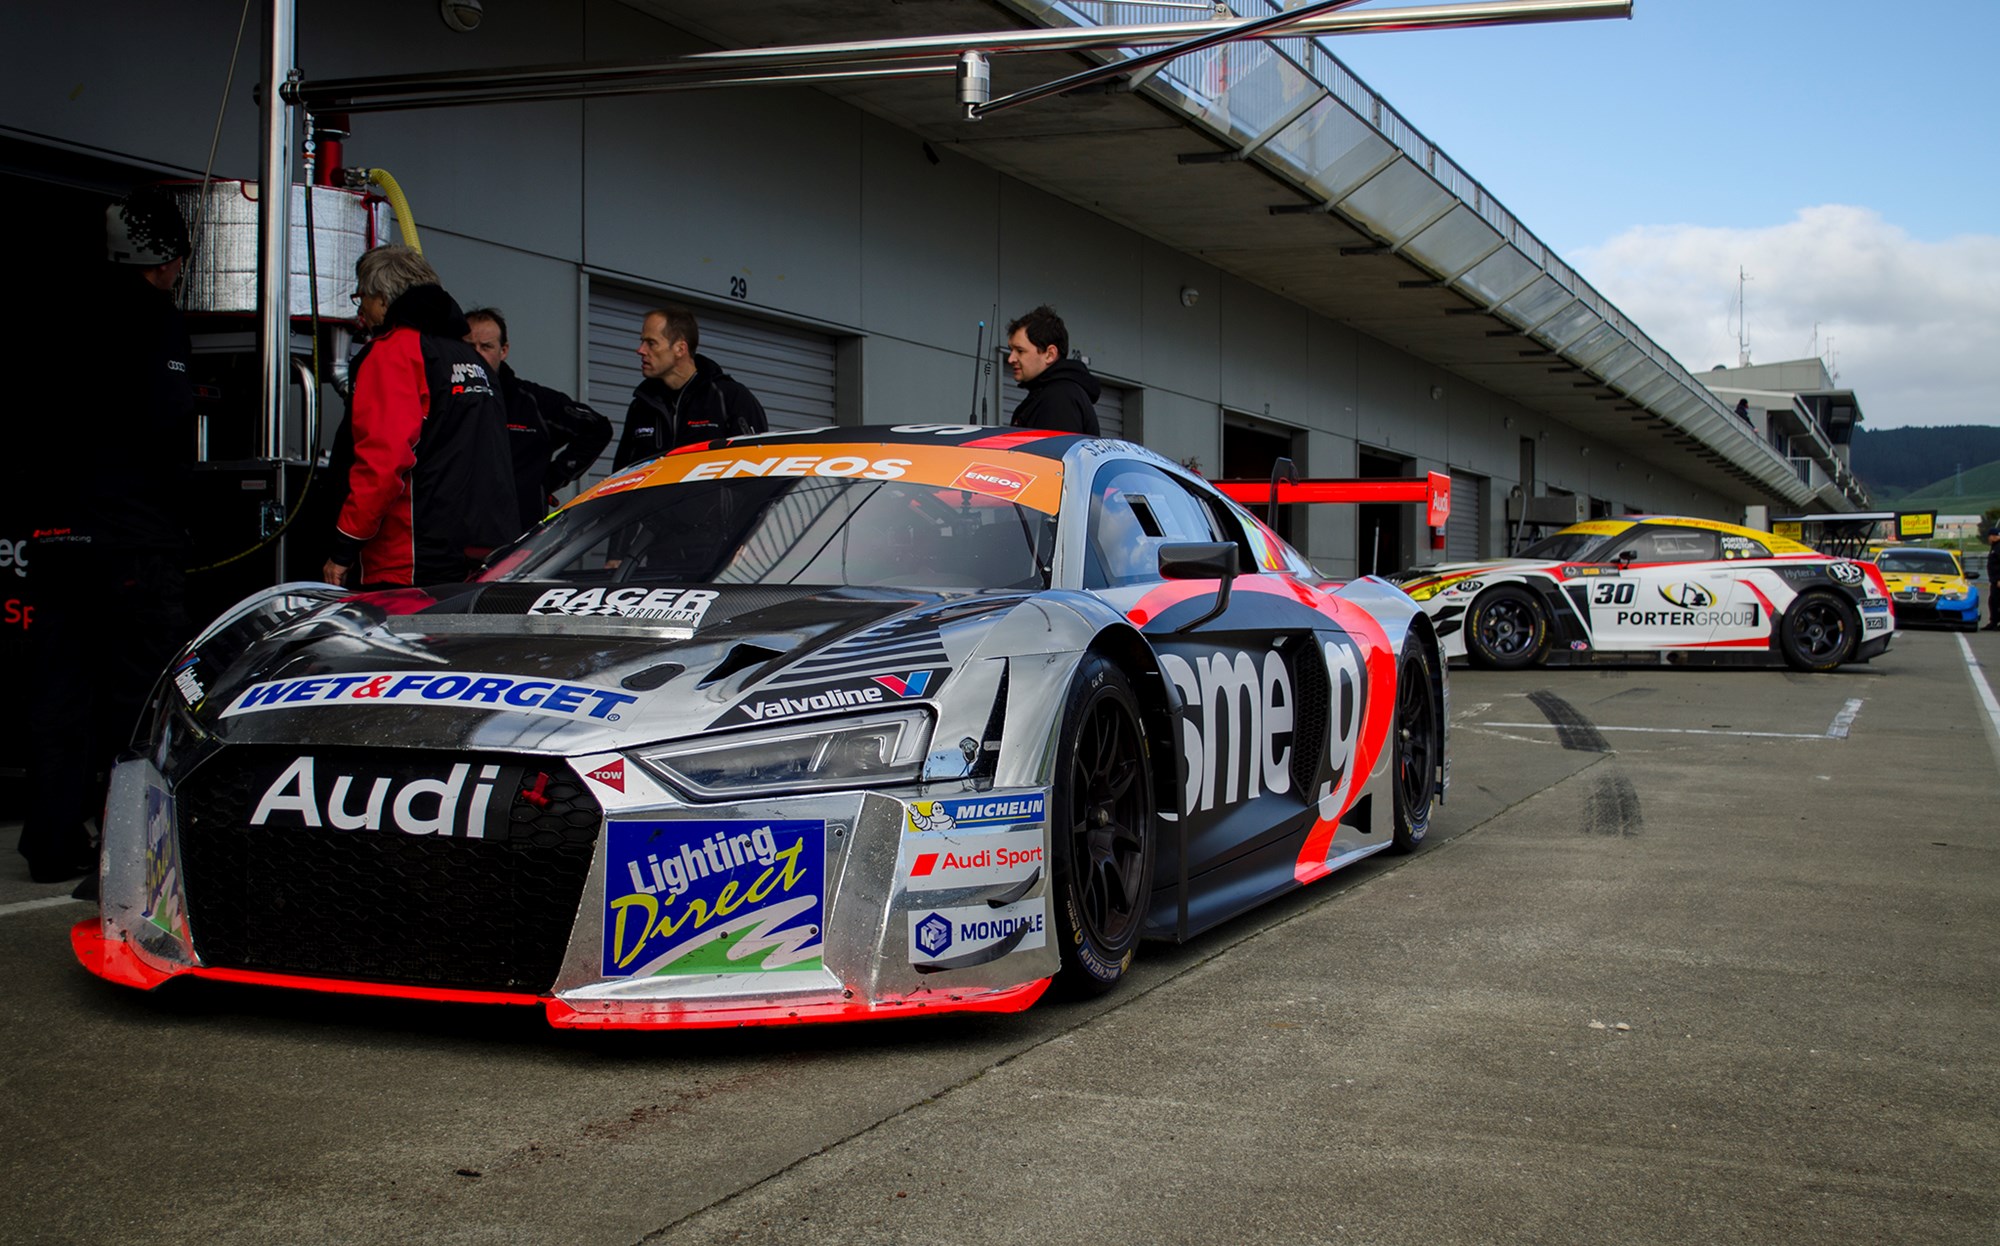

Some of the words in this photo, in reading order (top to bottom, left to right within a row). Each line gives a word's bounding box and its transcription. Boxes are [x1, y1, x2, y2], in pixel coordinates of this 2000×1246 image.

[730, 276, 747, 299] 29
[680, 456, 913, 481] ENEOS
[965, 471, 1021, 491] ENEOS
[1432, 490, 1448, 512] Audi
[1784, 569, 1817, 579] Hytera
[529, 588, 720, 616] RACER
[1594, 583, 1635, 604] 30
[626, 607, 700, 624] PRODUCTS
[738, 686, 884, 721] Valvoline
[1156, 641, 1363, 822] smeg
[592, 769, 623, 781] TOW
[250, 756, 500, 838] Audi
[956, 799, 1043, 819] MICHELIN
[627, 824, 776, 897] Lighting
[942, 850, 991, 871] Audi
[996, 846, 1043, 868] Sport
[610, 836, 806, 970] Direct
[1080, 947, 1120, 980] MICHELIN
